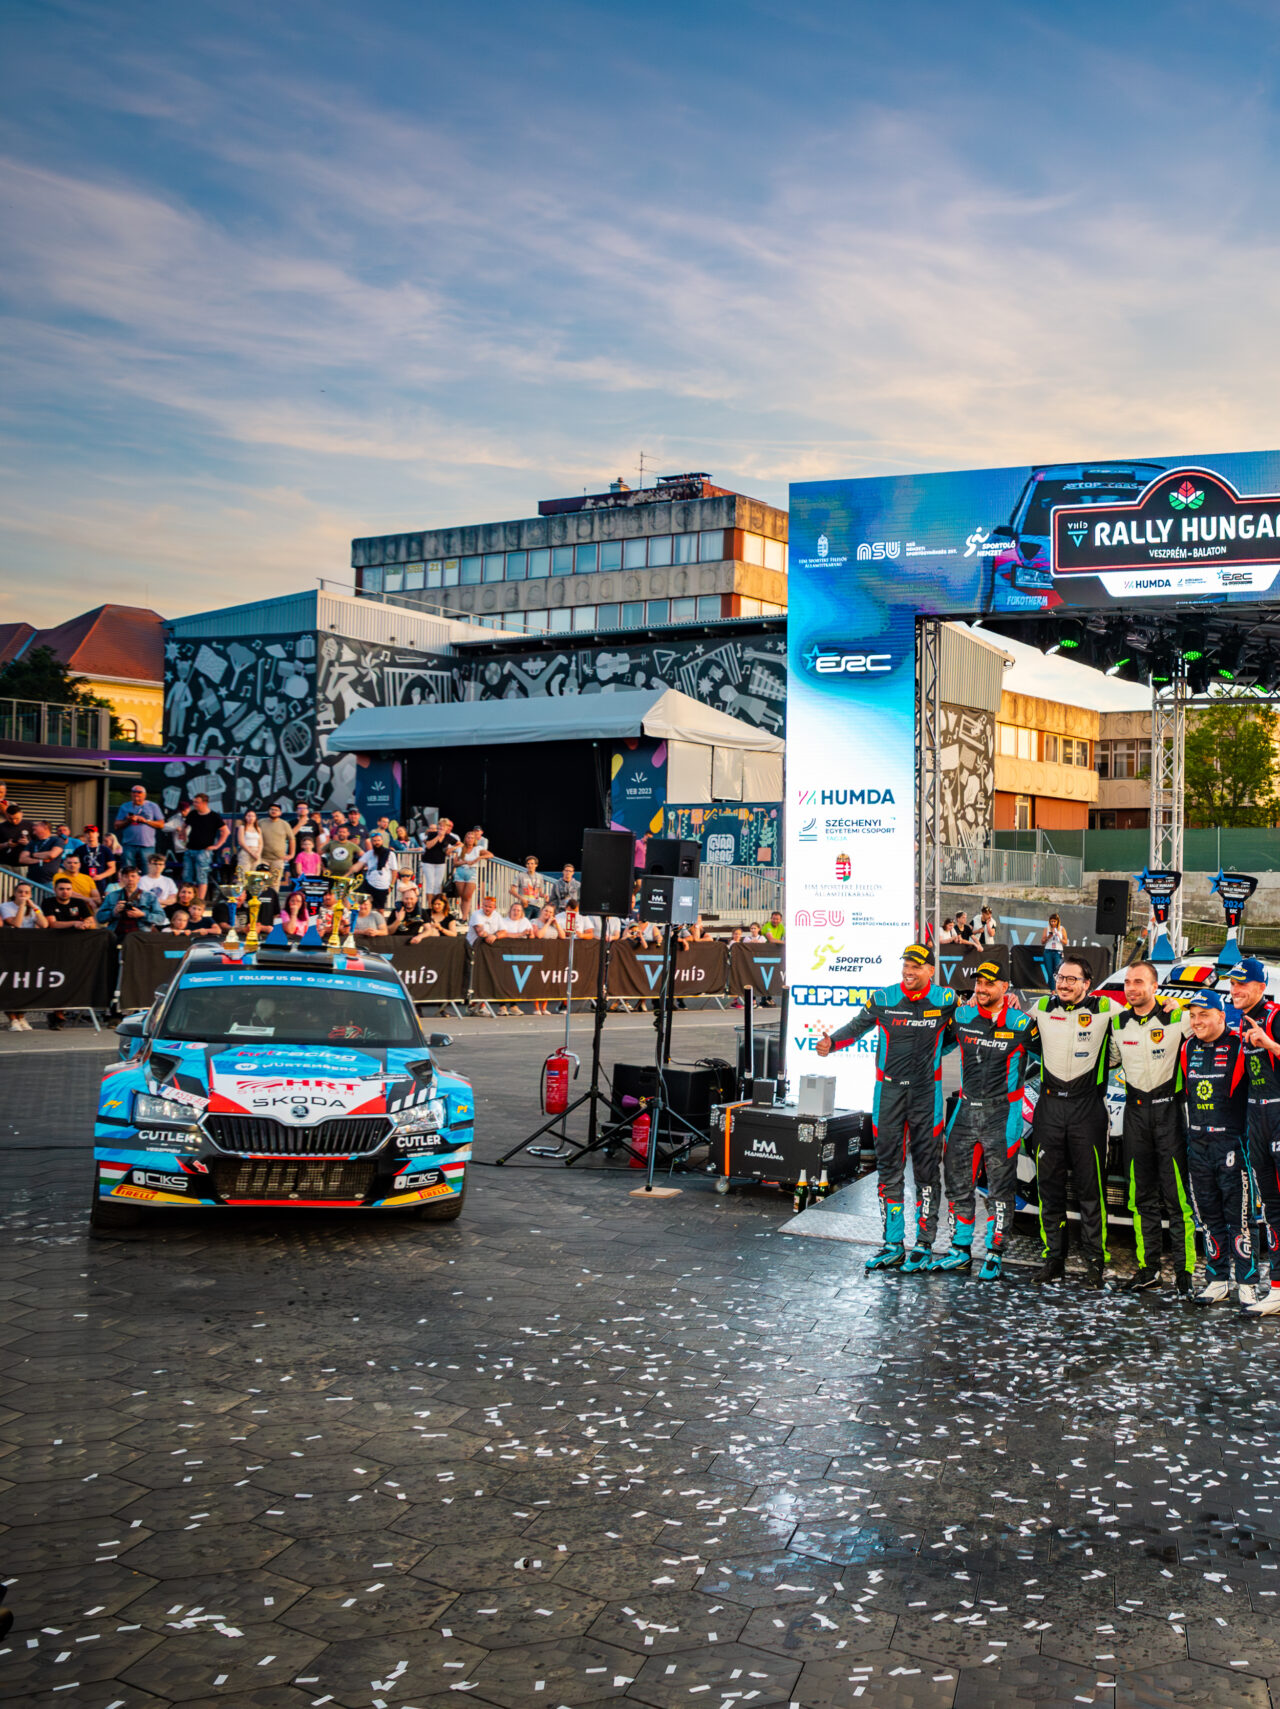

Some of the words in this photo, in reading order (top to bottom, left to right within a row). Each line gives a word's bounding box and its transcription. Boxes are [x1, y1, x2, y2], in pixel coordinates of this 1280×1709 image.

[1094, 519, 1174, 546] RALLY
[982, 540, 1016, 550] SPORTOLÓ
[1149, 548, 1187, 559] VESZPRÉM
[1193, 546, 1227, 558] BALATON
[1135, 579, 1171, 589] HUMDA
[815, 654, 891, 673] ERC
[638, 787, 652, 795] 2023
[821, 789, 895, 805] HUMDA
[825, 817, 881, 827] SZÉCHENYI
[1151, 896, 1171, 905] 2024
[1223, 900, 1244, 909] 2024
[1158, 909, 1164, 921] 1
[1230, 914, 1236, 926] 1
[836, 954, 882, 964] SPORTOLÓ
[286, 1079, 361, 1091] HRT
[396, 1134, 442, 1148] CUTLER
[1225, 1151, 1235, 1167] 8
[115, 1185, 159, 1200] PIRELLI
[417, 1183, 450, 1199] PIRELLI
